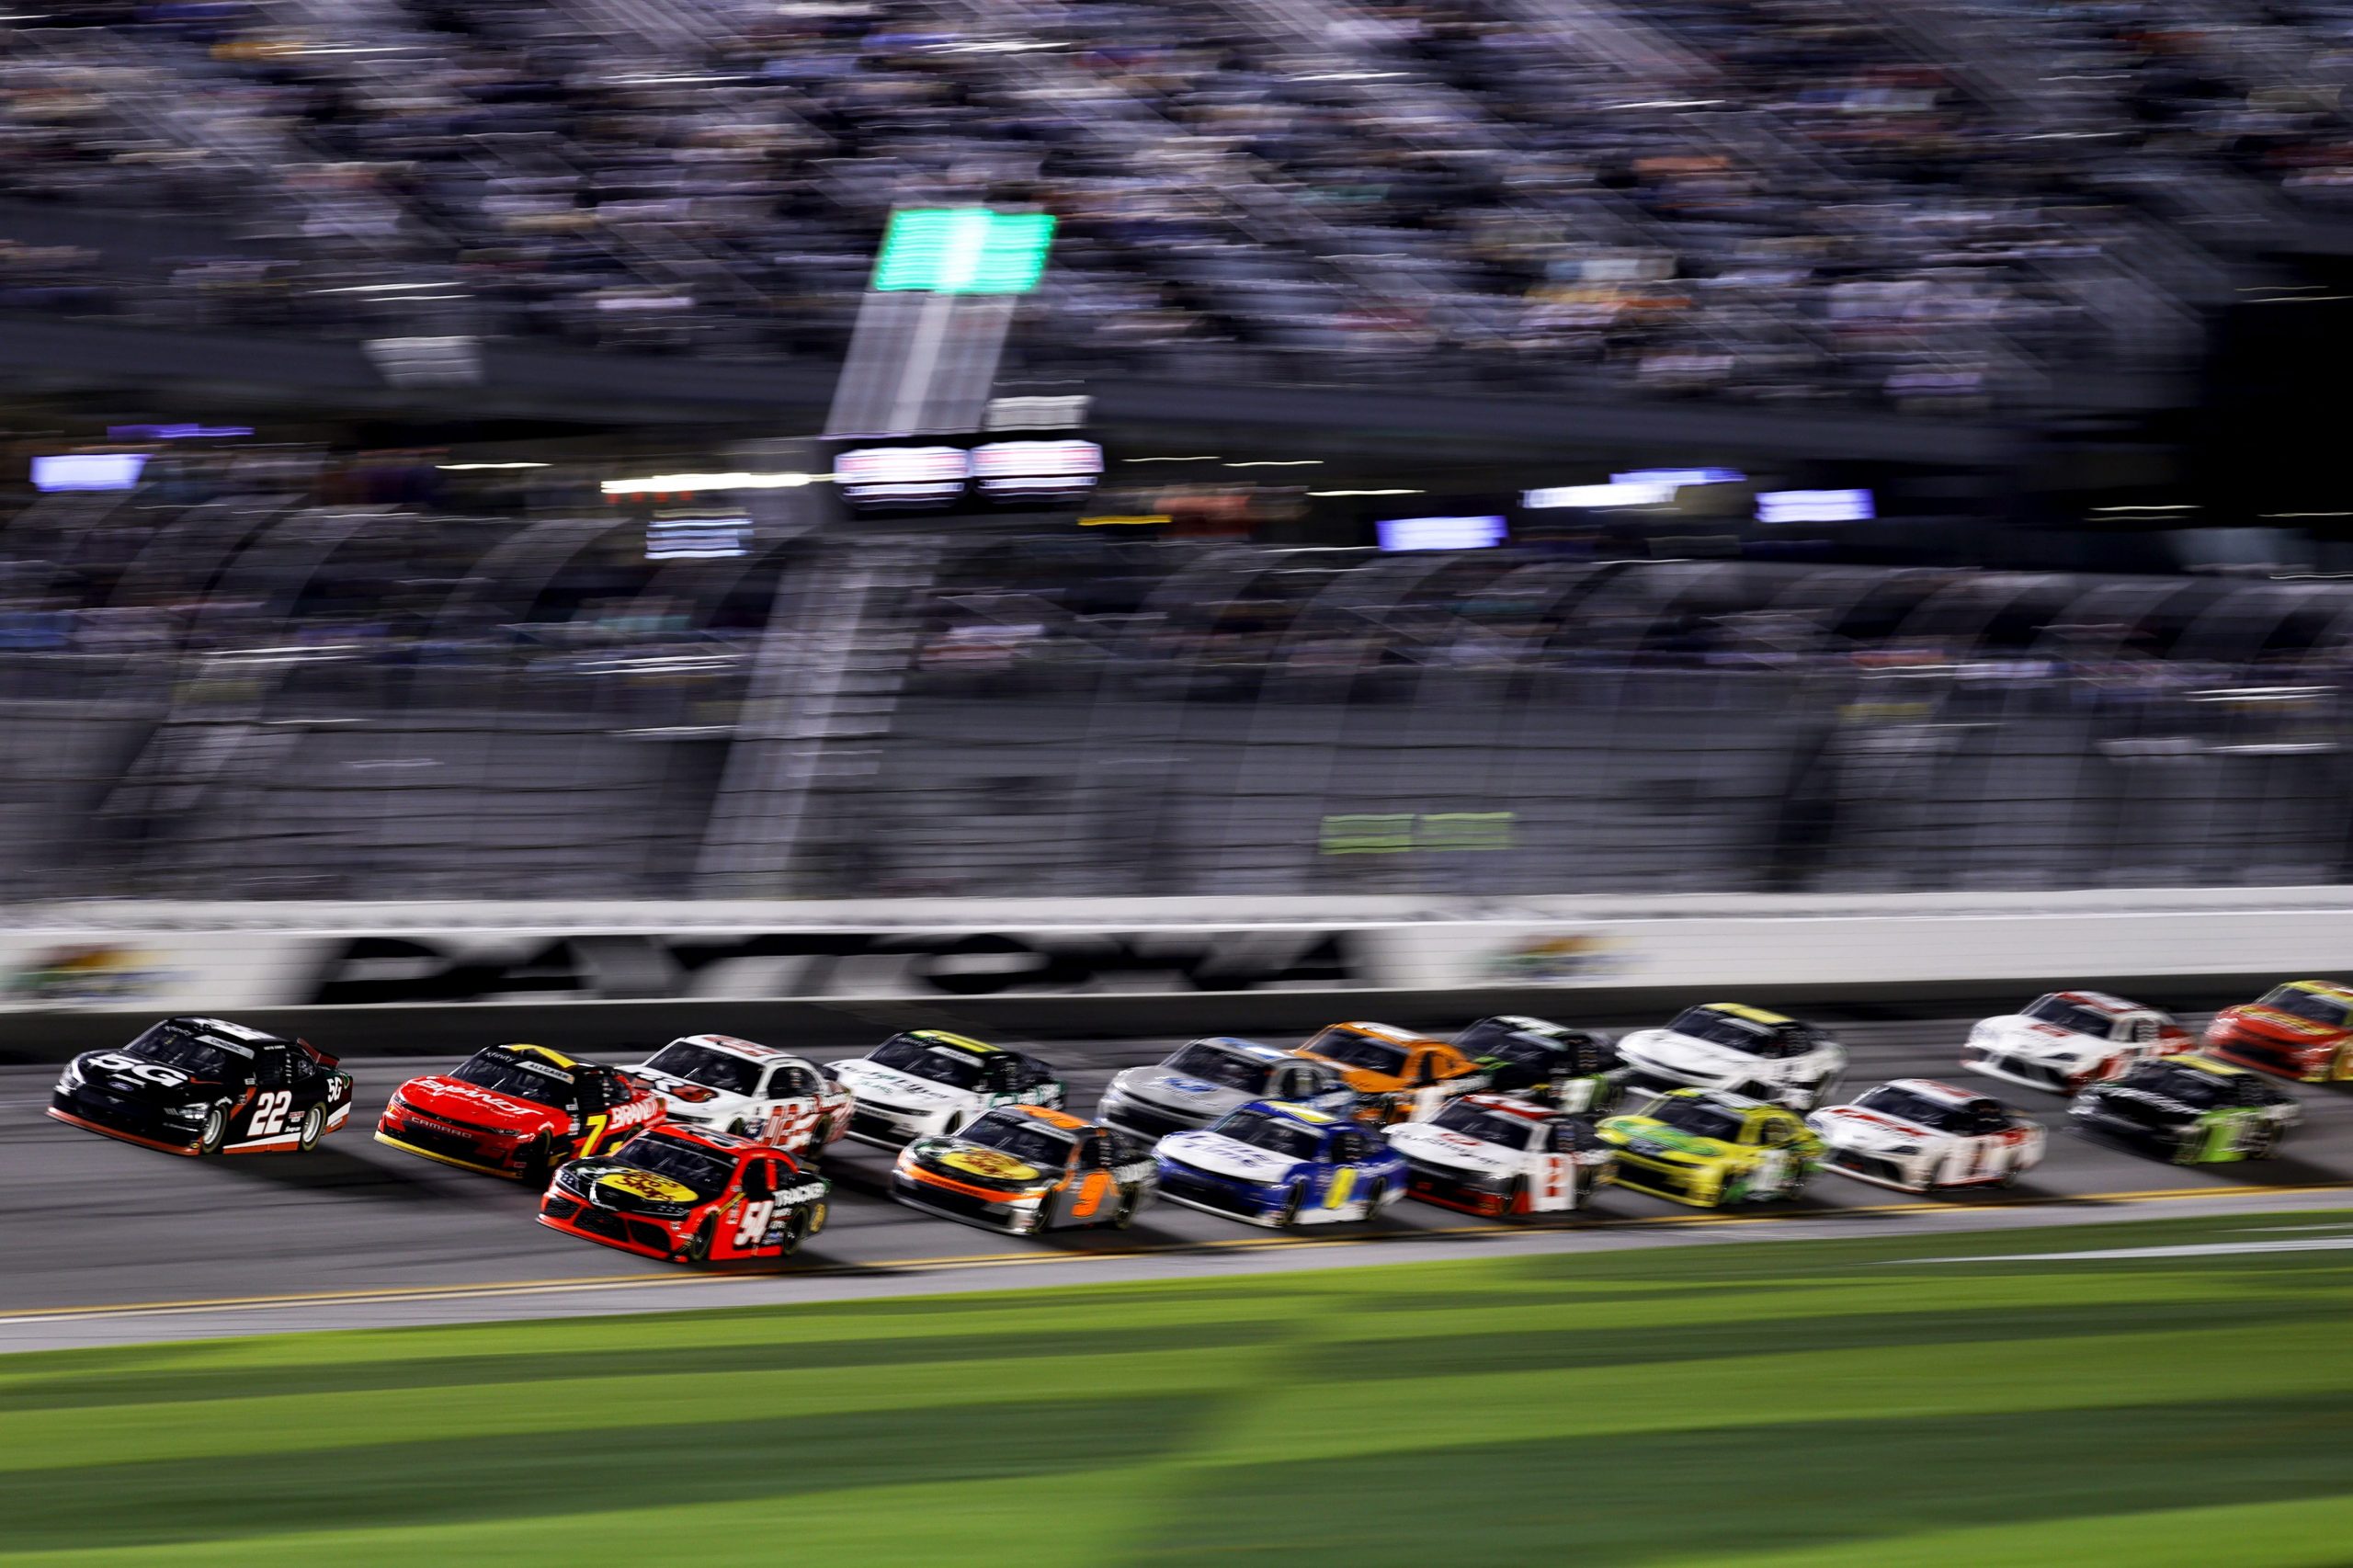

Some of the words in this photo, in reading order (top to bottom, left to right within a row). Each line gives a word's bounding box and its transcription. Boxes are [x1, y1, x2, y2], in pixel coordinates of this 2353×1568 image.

[86, 1053, 188, 1087] 5G
[326, 1076, 343, 1103] 5G
[246, 1090, 292, 1137] 22
[411, 1116, 472, 1139] CAMARO
[578, 1114, 608, 1158] 7
